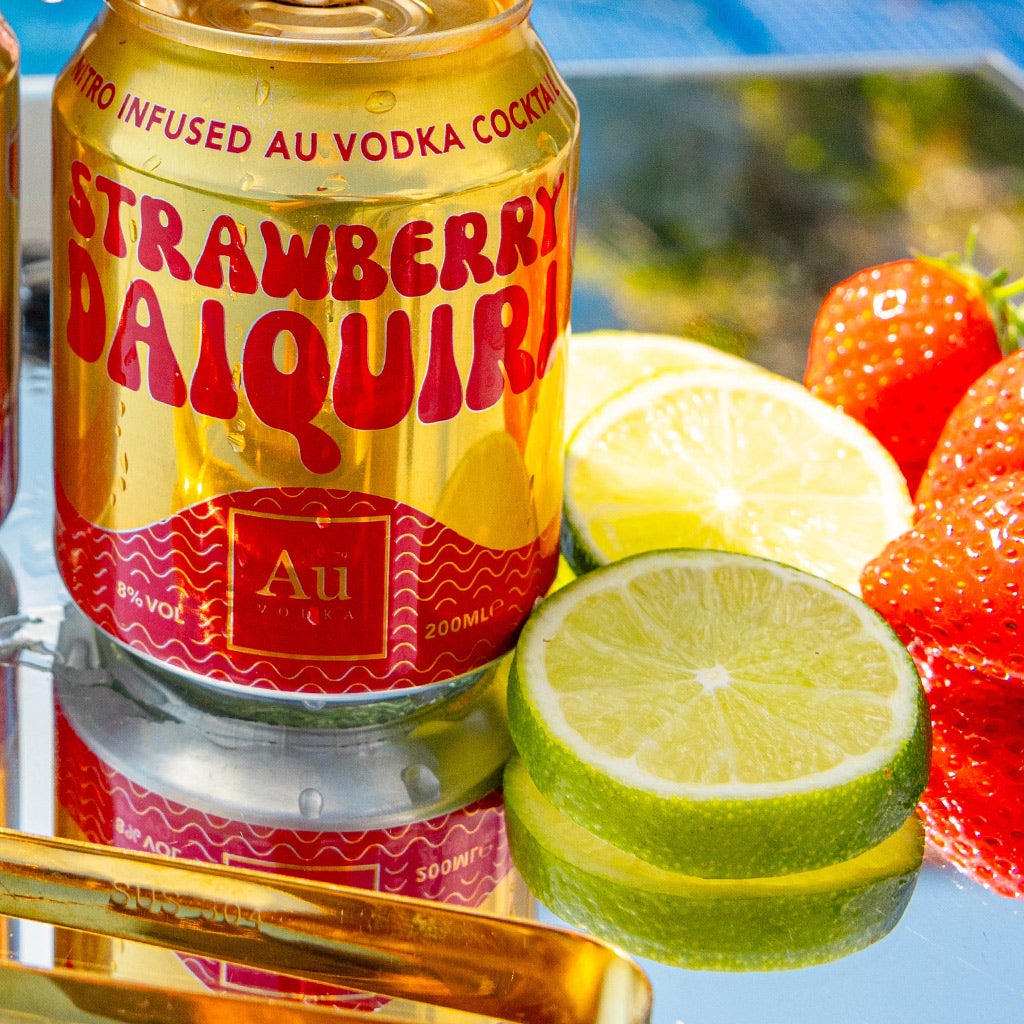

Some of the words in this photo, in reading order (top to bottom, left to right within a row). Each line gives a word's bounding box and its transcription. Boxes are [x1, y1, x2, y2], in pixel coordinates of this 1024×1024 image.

[71, 54, 116, 111] NITRO
[117, 93, 253, 154] INFUSED
[264, 130, 318, 163] AU
[333, 124, 466, 163] VODKA
[472, 71, 561, 144] COCKTAIL
[68, 160, 565, 302] STRAWBERRY
[66, 239, 558, 474] DAIQUIRI
[117, 580, 144, 608] 8%
[145, 594, 186, 625] VOL
[255, 548, 352, 601] Au
